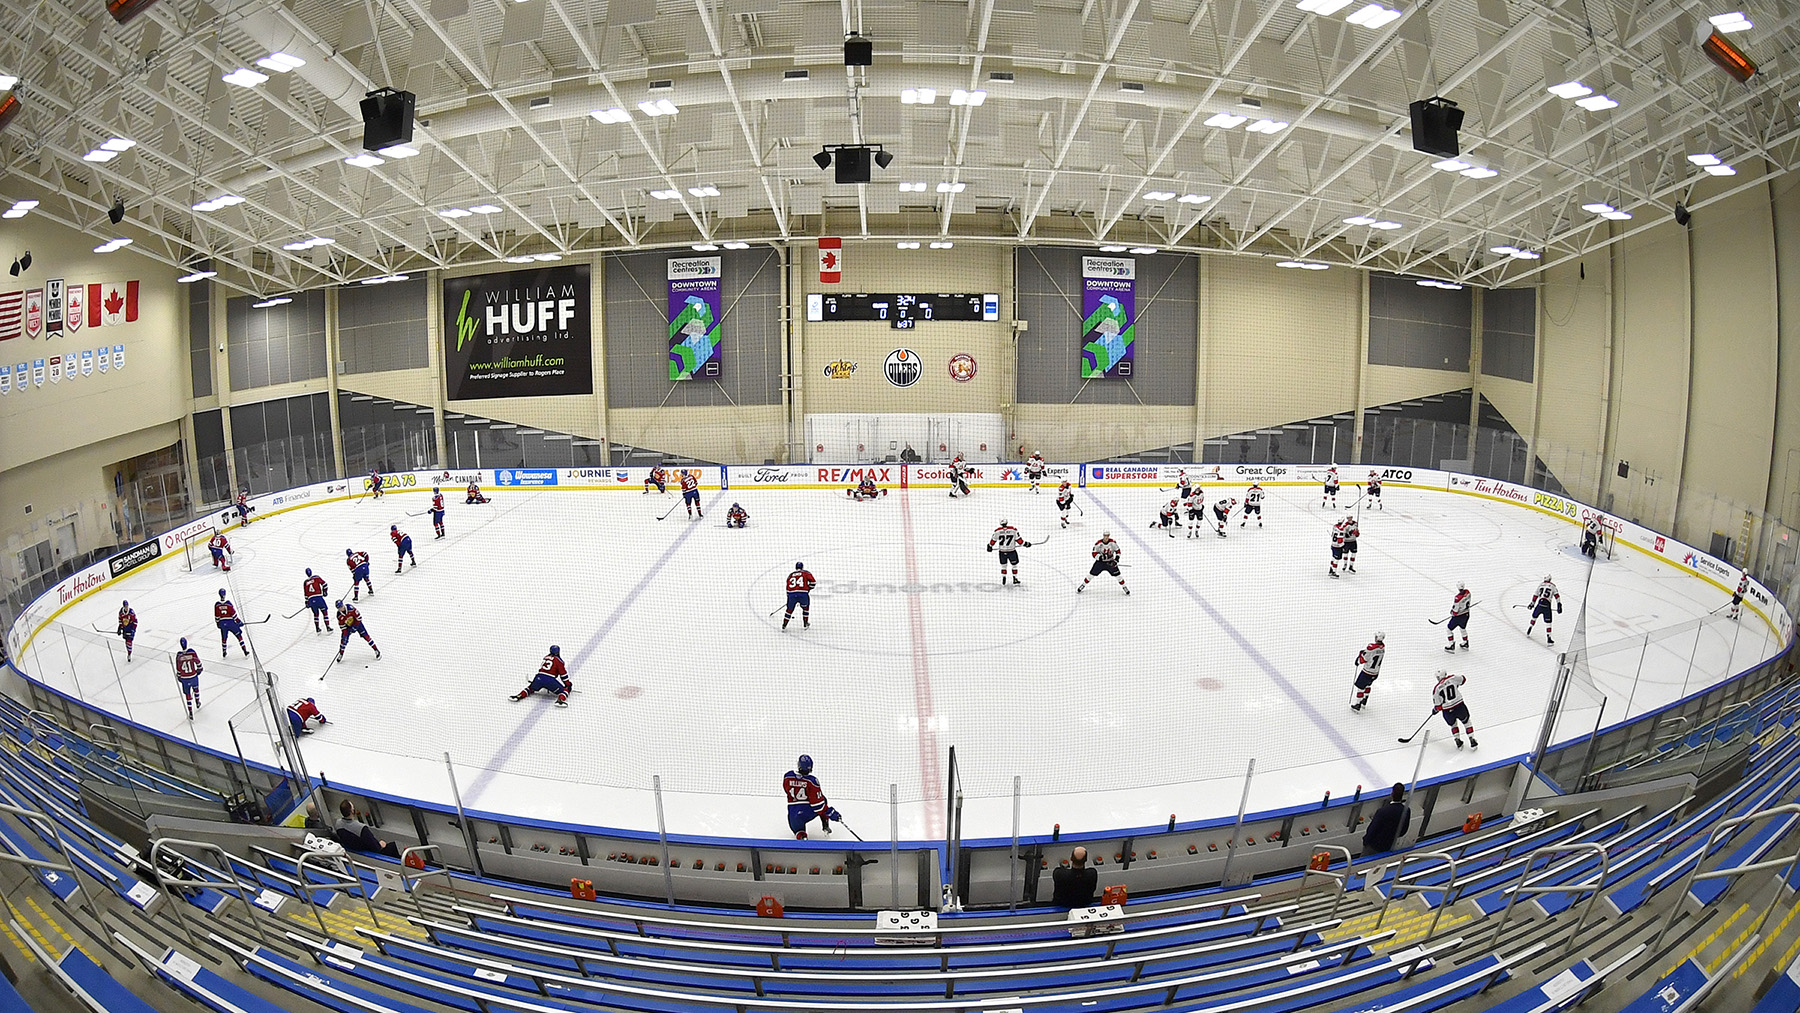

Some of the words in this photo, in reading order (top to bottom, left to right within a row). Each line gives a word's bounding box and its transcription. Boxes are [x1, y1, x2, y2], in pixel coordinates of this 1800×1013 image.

[672, 260, 710, 268] Recreation
[1087, 260, 1124, 268] Recreation
[672, 280, 717, 288] DOWNTOWN
[1086, 280, 1131, 288] DOWNTOWN
[485, 284, 575, 304] WILLIAM
[830, 304, 836, 313] 0
[880, 308, 887, 319] 0
[900, 310, 906, 318] 0
[925, 308, 932, 319] 0
[974, 304, 980, 312] 0
[486, 298, 575, 336] HUFF
[487, 334, 548, 344] advertising
[554, 332, 574, 340] ltd.
[470, 354, 564, 370] www.williamhuff.com
[515, 471, 553, 480] Wawanesa
[567, 470, 611, 479] JOURNIE
[754, 468, 789, 482] Ford
[818, 468, 890, 482] RE/MAX
[1236, 466, 1262, 475] Great
[1266, 466, 1287, 475] Clips
[1381, 469, 1412, 480] ATCO
[402, 474, 416, 486] 73
[1475, 479, 1492, 494] Tim
[1492, 482, 1528, 503] Hortons
[272, 496, 284, 506] ATB
[284, 491, 311, 503] Financial
[1250, 493, 1260, 502] 21
[1534, 492, 1564, 512] PIZZA
[1564, 502, 1577, 518] 73
[124, 546, 150, 563] SANDMAN
[138, 552, 150, 562] GROUP
[1700, 556, 1716, 570] Service
[1715, 563, 1730, 578] Experts
[789, 576, 804, 588] 34
[57, 584, 73, 605] Tim
[73, 572, 106, 598] Hortons
[1750, 586, 1769, 606] RAM
[182, 660, 193, 674] 41
[1440, 684, 1456, 703] 10
[789, 780, 808, 788] WILLIAMS
[788, 788, 808, 801] 14
